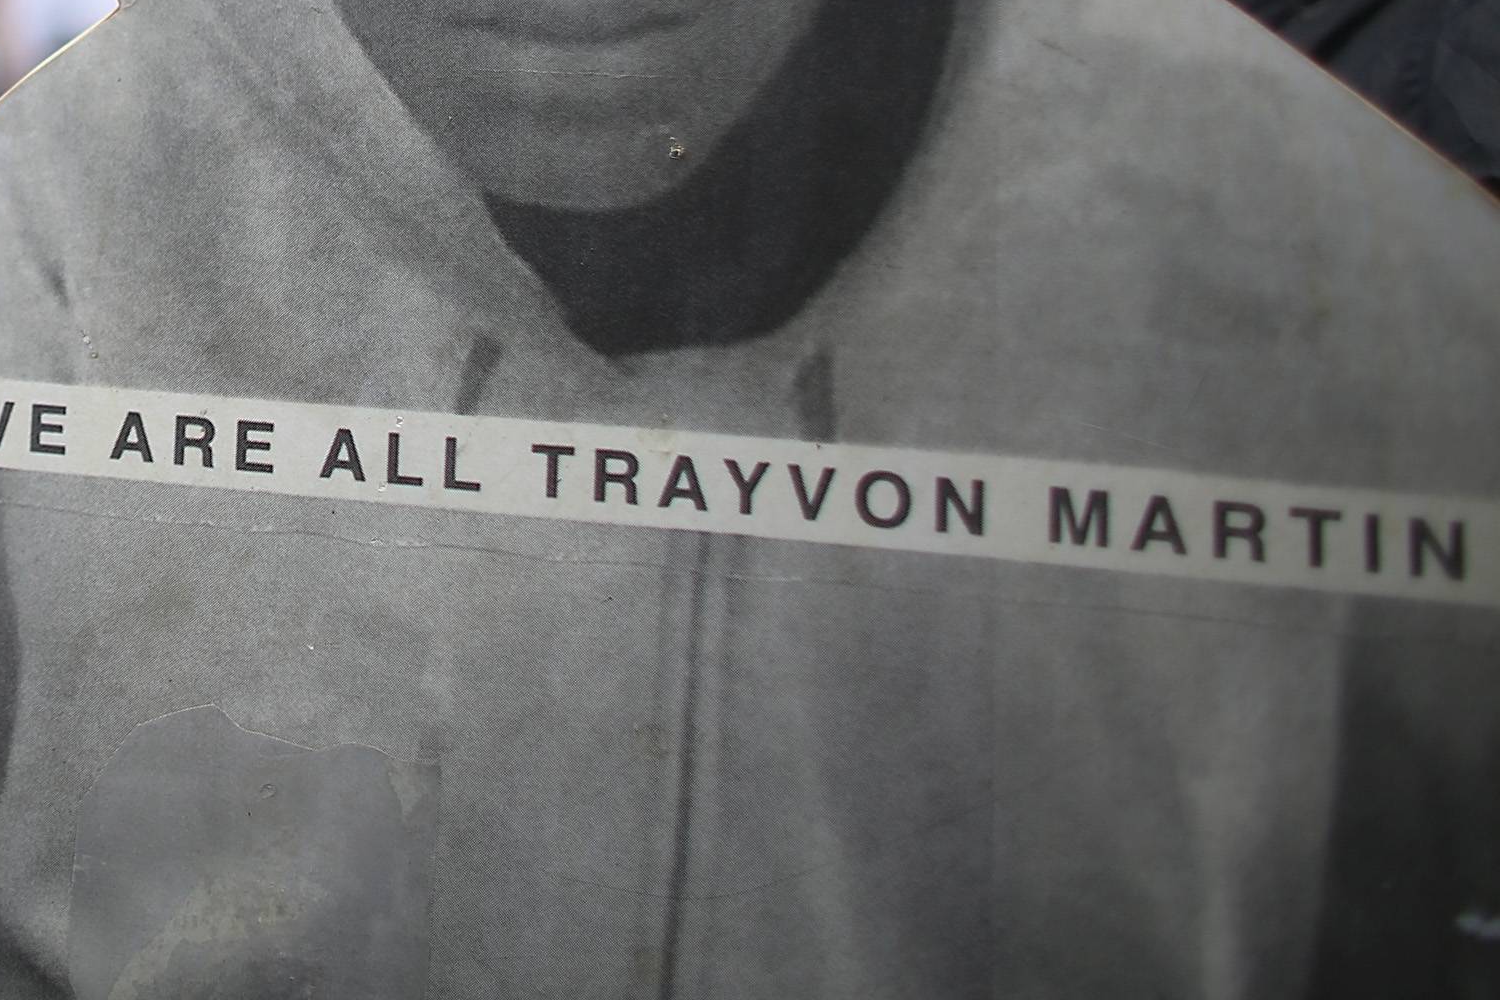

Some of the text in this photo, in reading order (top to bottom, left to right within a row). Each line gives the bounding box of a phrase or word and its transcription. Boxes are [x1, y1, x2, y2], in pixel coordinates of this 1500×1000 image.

[109, 410, 275, 474] ARE
[319, 427, 482, 492] ALL
[531, 443, 986, 537] TRAYVON
[1047, 485, 1467, 581] MARTIN
